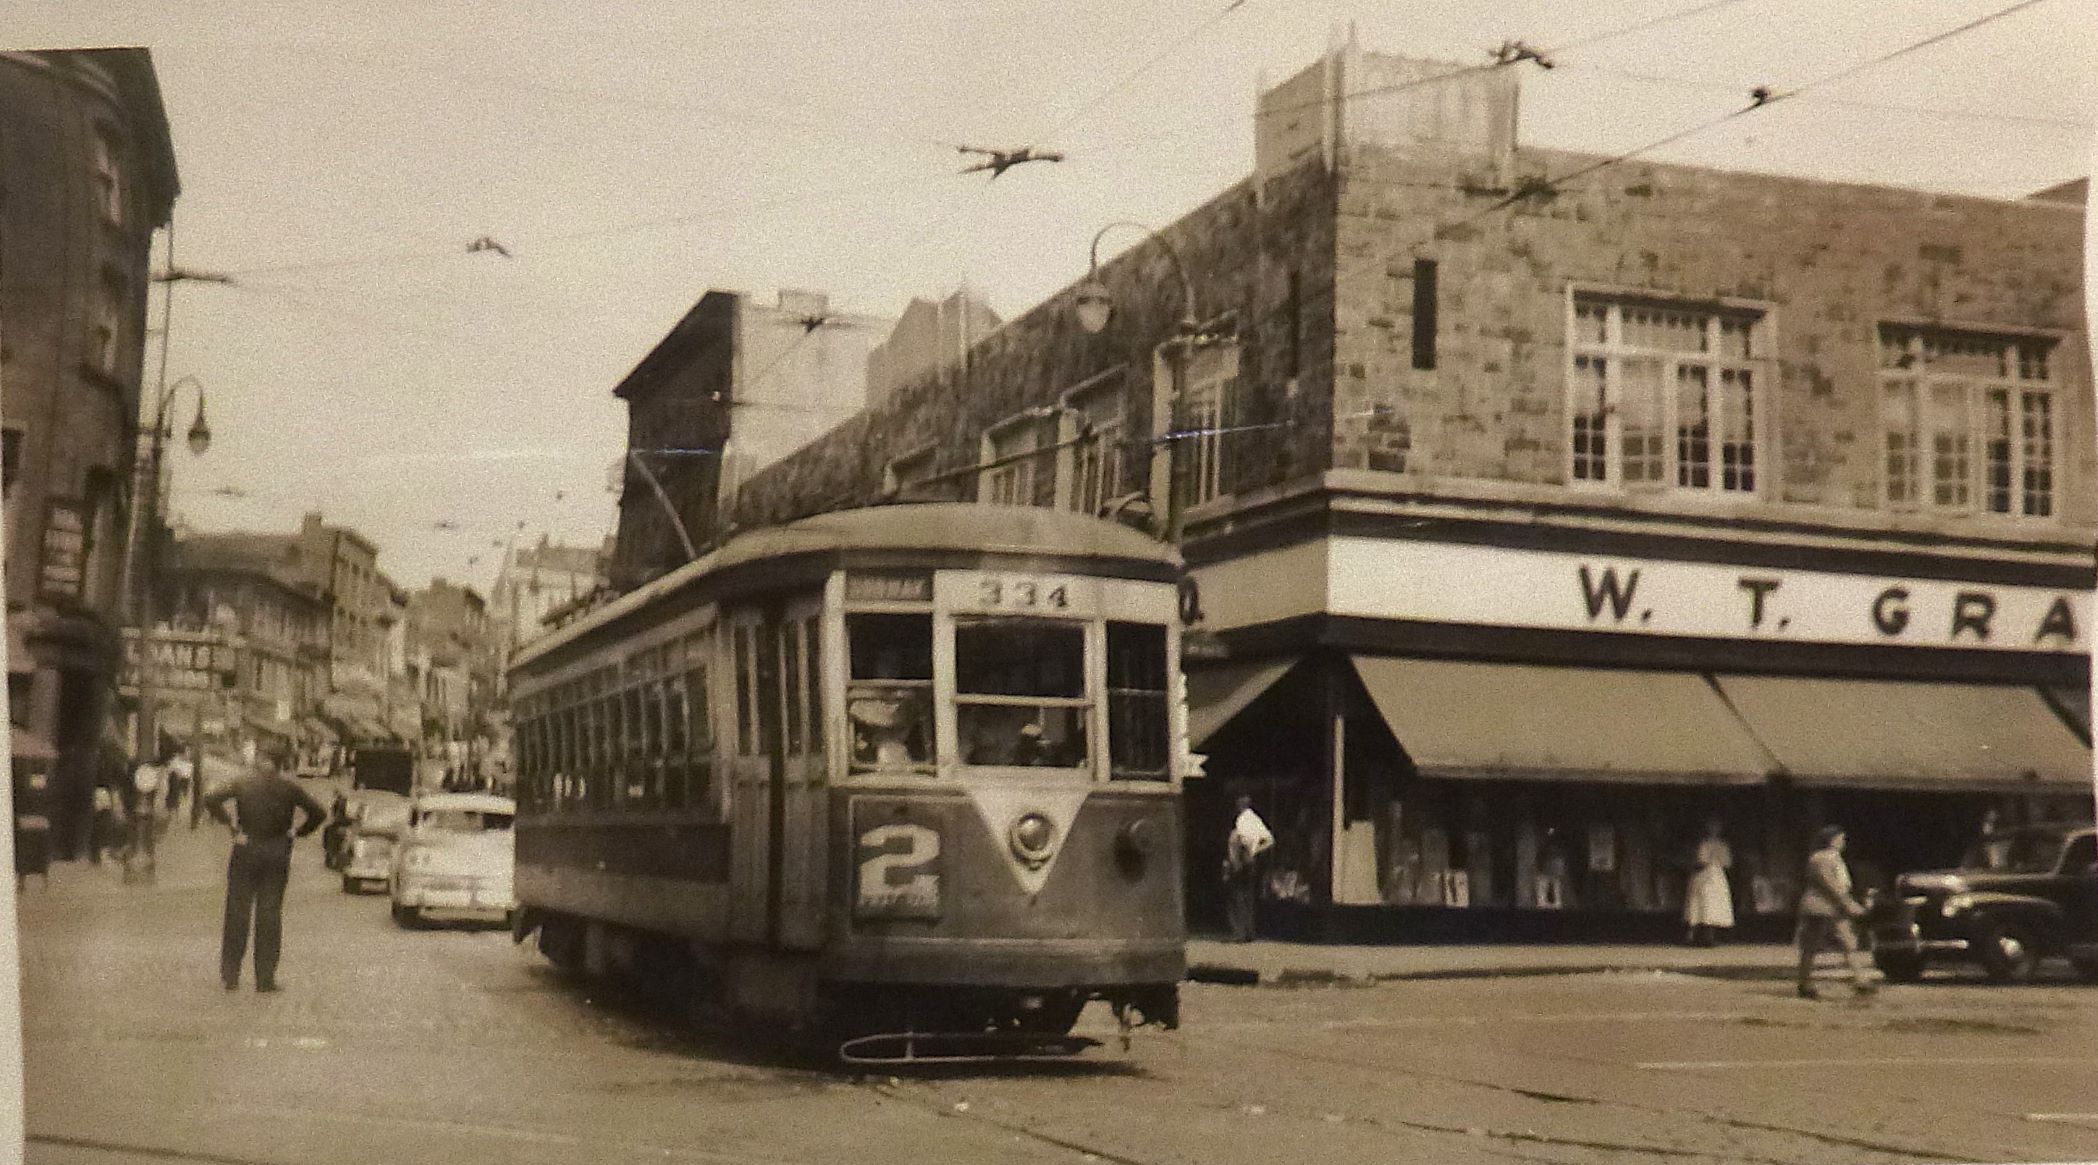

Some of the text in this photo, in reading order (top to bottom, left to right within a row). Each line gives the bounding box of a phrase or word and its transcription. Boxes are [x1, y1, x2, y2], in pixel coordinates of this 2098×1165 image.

[978, 578, 1068, 608] 334
[1579, 564, 2079, 644] W. T. GRA
[859, 824, 941, 901] 2
